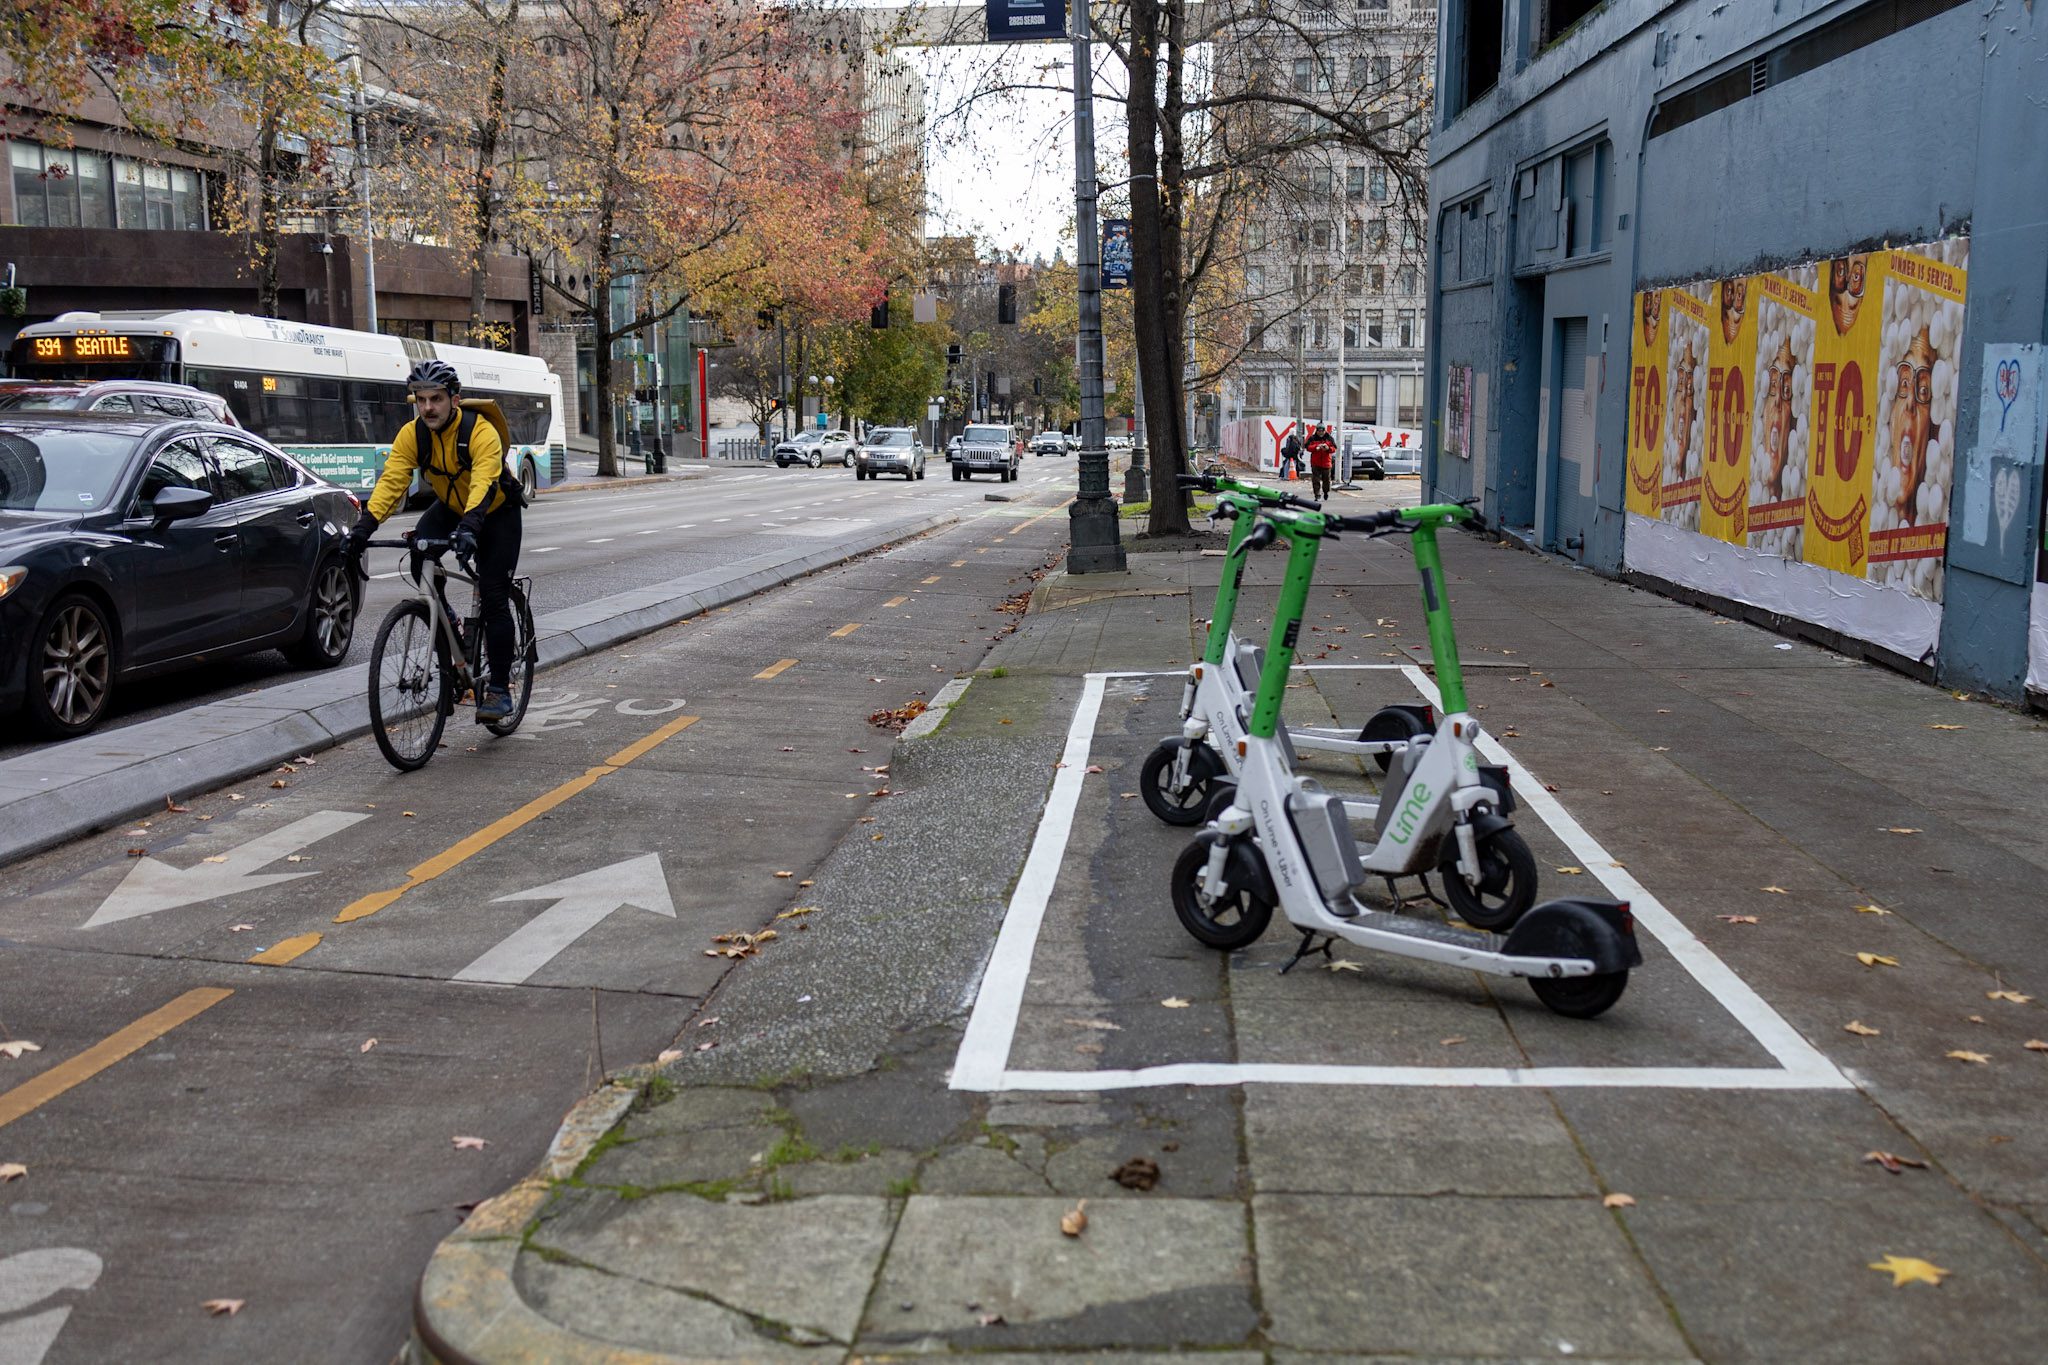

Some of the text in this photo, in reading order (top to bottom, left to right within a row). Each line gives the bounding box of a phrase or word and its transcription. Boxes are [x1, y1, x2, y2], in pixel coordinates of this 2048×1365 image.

[1024, 14, 1046, 25] SEASON
[1890, 254, 1915, 277] DINNER
[1917, 264, 1925, 281] IS
[35, 336, 129, 356] 594 SEATTLE
[313, 346, 324, 356] RIDE
[331, 349, 344, 358] WAVE
[262, 377, 276, 391] 594
[311, 453, 323, 464] Good
[337, 455, 348, 466] pass
[352, 455, 364, 464] save
[320, 467, 338, 477] express
[1389, 782, 1432, 845] Lime
[1265, 819, 1279, 848] Lime
[1279, 858, 1293, 888] Uber
